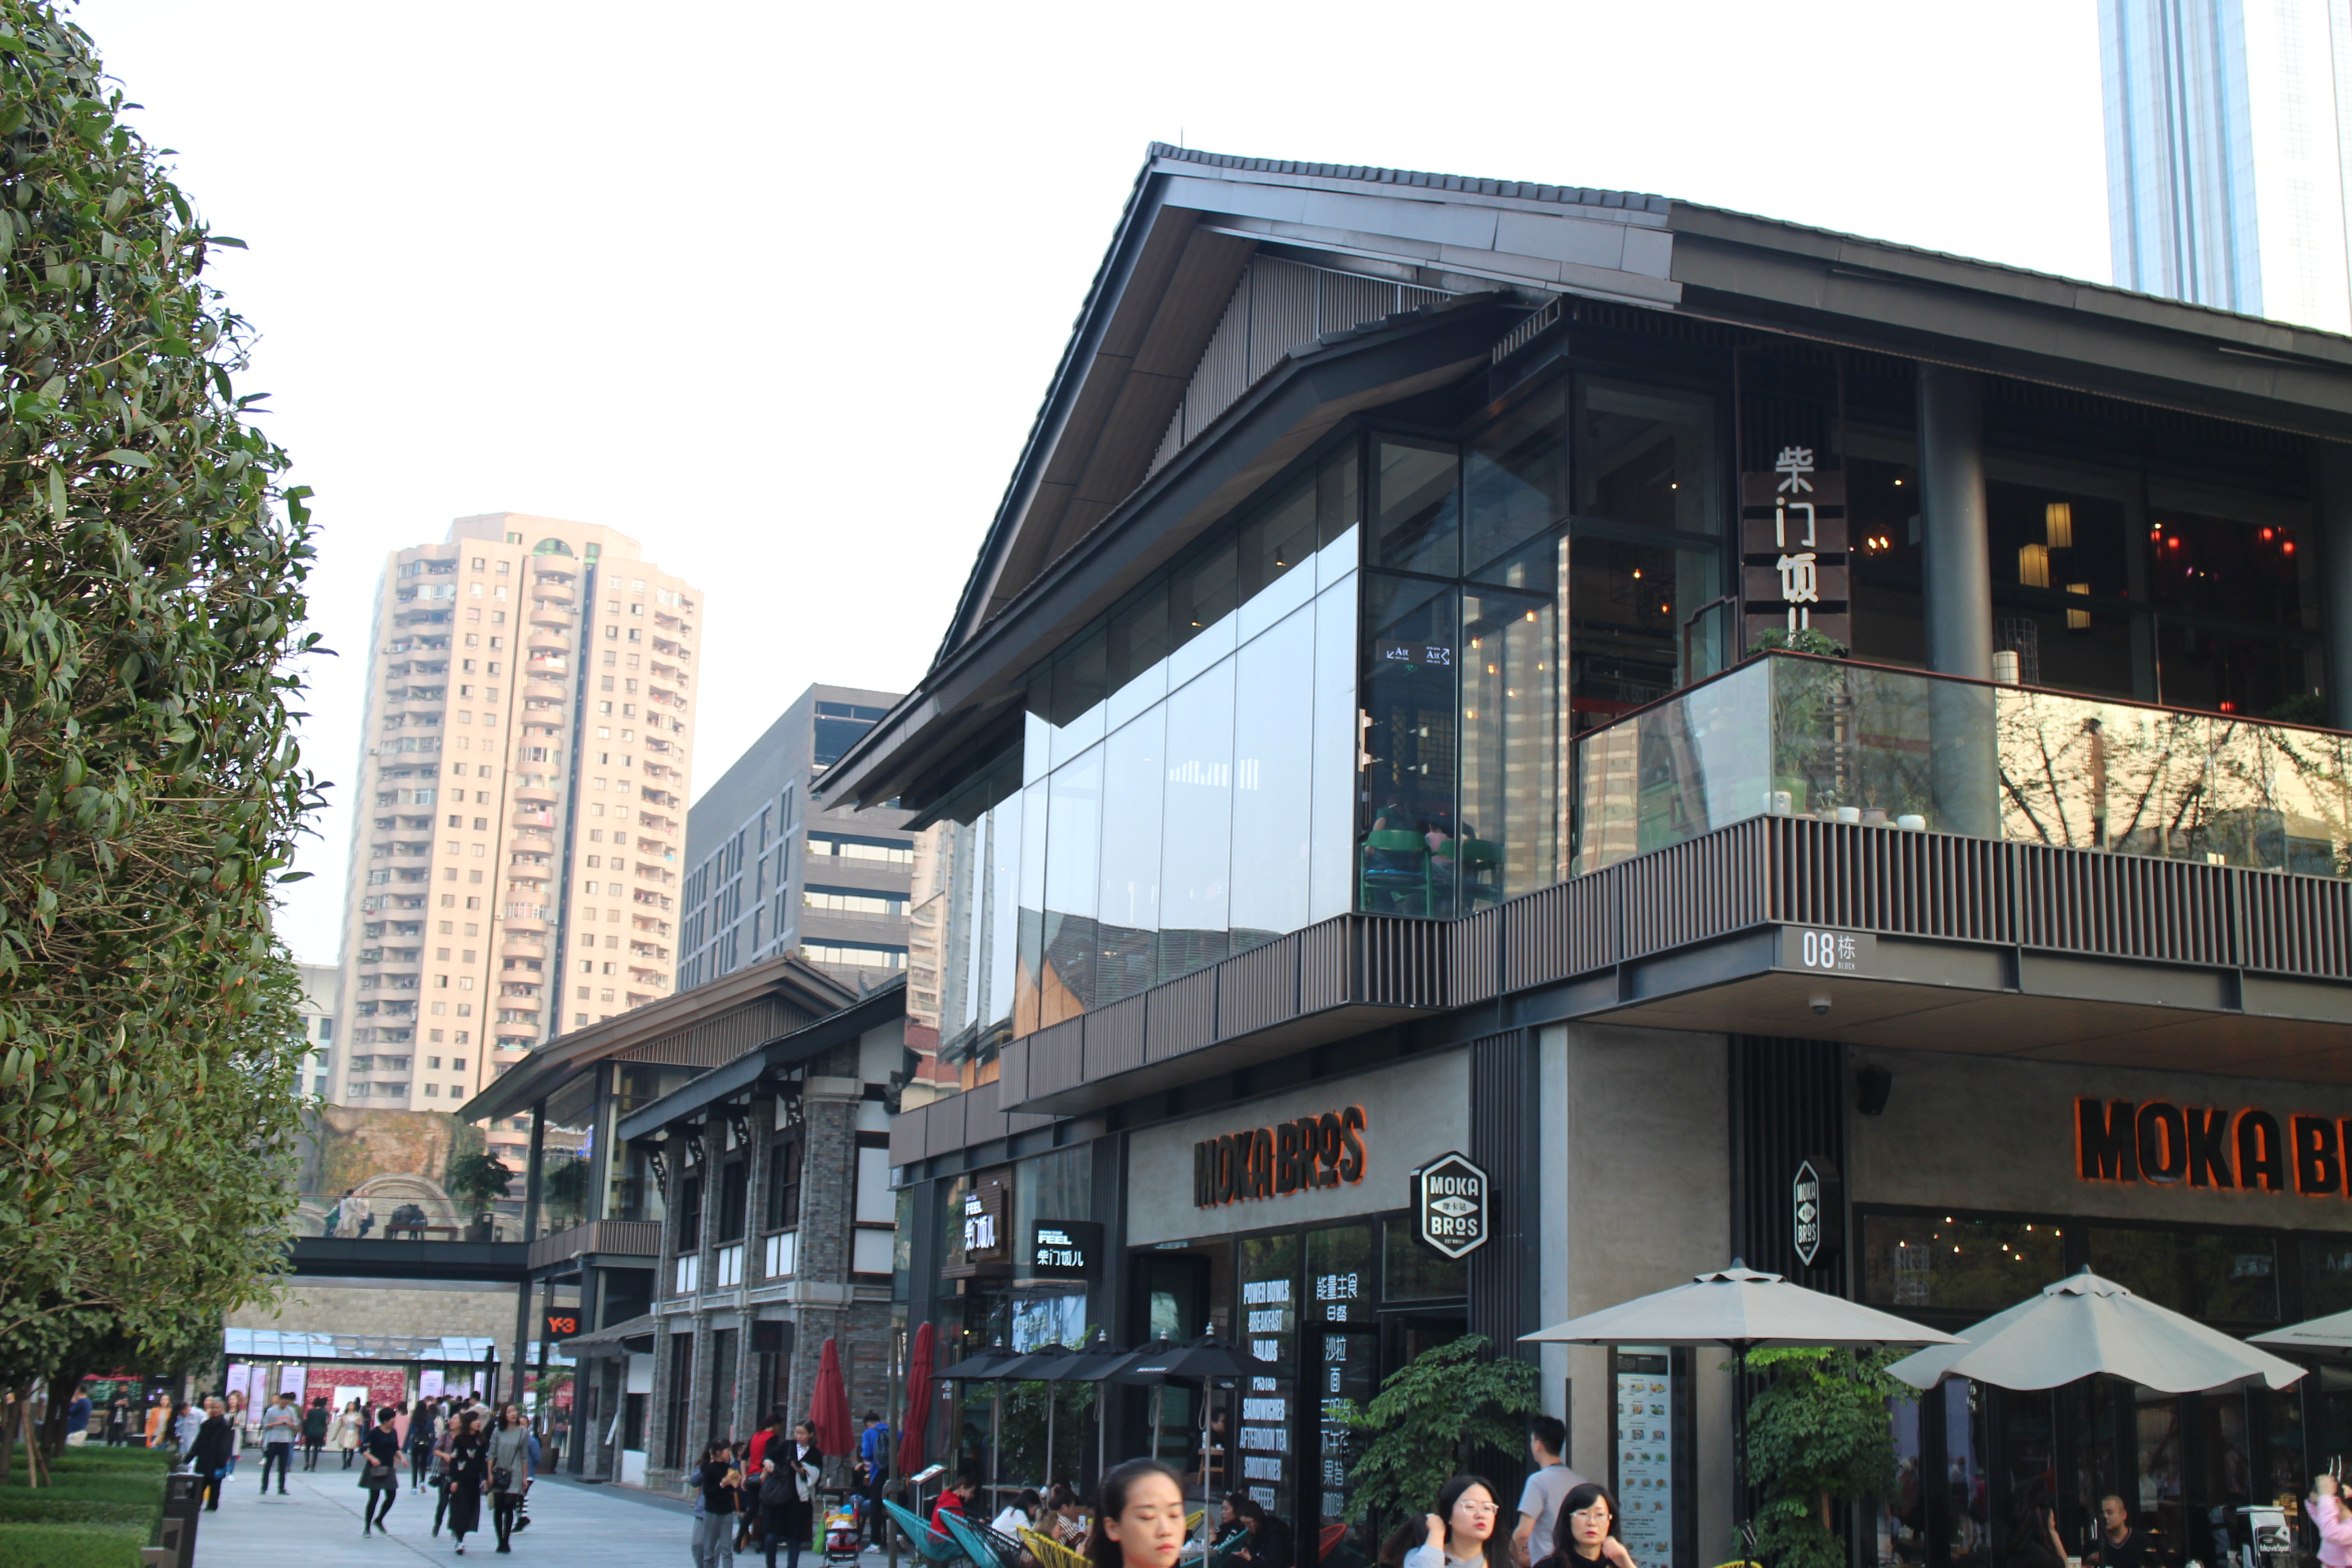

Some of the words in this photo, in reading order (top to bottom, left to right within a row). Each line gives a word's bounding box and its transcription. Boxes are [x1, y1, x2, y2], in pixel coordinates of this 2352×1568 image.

[1803, 931, 1834, 968] 08
[1838, 934, 1856, 960] 栋
[1838, 962, 1856, 970] BLOCK
[2074, 1096, 2285, 1192] MOKA
[1194, 1128, 1275, 1208] MOKA
[1276, 1105, 1367, 1195] BROS
[1430, 1176, 1478, 1196] MOKA
[1797, 1181, 1816, 1203] MOKA
[966, 1200, 983, 1215] FEEL
[965, 1215, 995, 1251] 柴门饭儿
[1431, 1216, 1477, 1236] BROS
[1798, 1223, 1816, 1243] BROS
[1037, 1235, 1073, 1245] FEEL
[1037, 1249, 1084, 1267] 柴门饭儿
[1243, 1282, 1266, 1305] POWER
[1267, 1279, 1290, 1303] BOWLS
[1317, 1273, 1358, 1301] 能量主食
[548, 1317, 576, 1333] Y-3
[1249, 1310, 1283, 1333] BREAKFAST
[1253, 1339, 1278, 1362] SALADS
[1326, 1337, 1346, 1361] 沙拉
[1330, 1367, 1341, 1392] 面
[1243, 1398, 1285, 1421] SANDWICHES
[1239, 1427, 1274, 1450] AFTERNOON
[1275, 1428, 1286, 1451] TEA
[1244, 1456, 1281, 1481] SMOOTHIES
